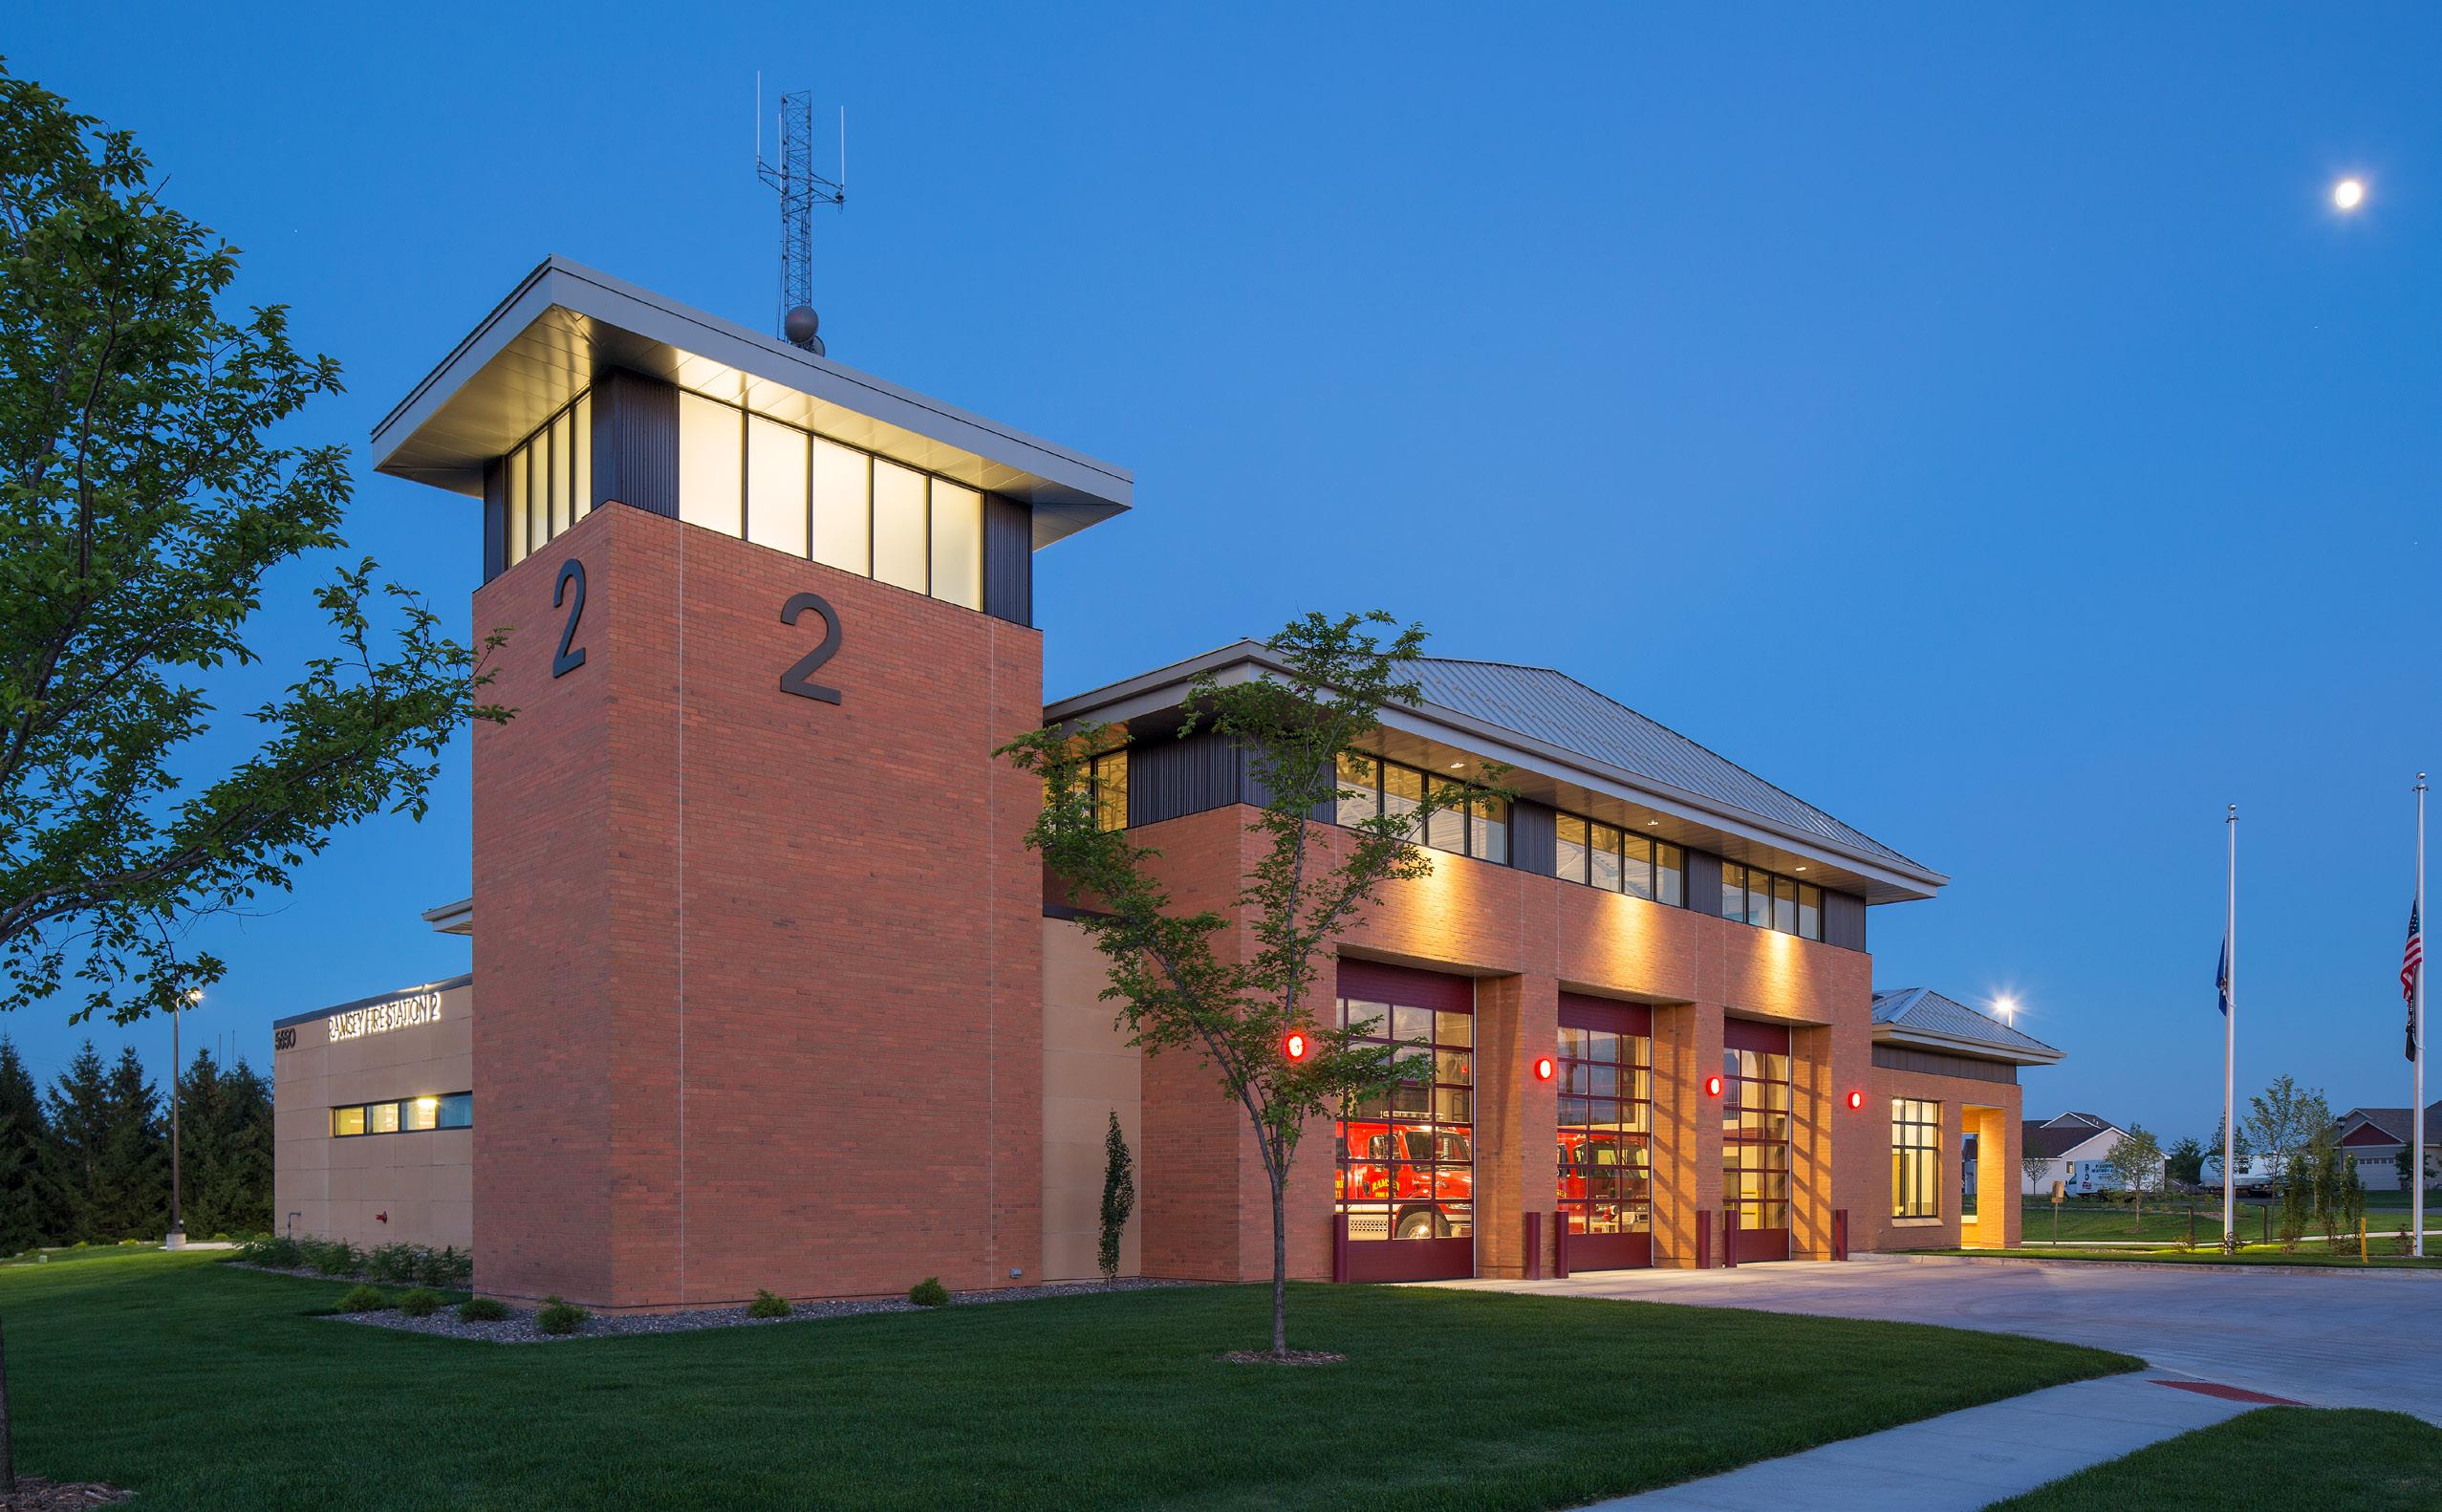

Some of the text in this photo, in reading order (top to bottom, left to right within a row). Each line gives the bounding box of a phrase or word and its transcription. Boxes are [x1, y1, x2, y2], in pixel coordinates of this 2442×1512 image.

[552, 558, 586, 679] 2
[780, 592, 842, 706] 2
[328, 993, 441, 1041] RAMSEY FIRE STATION 2
